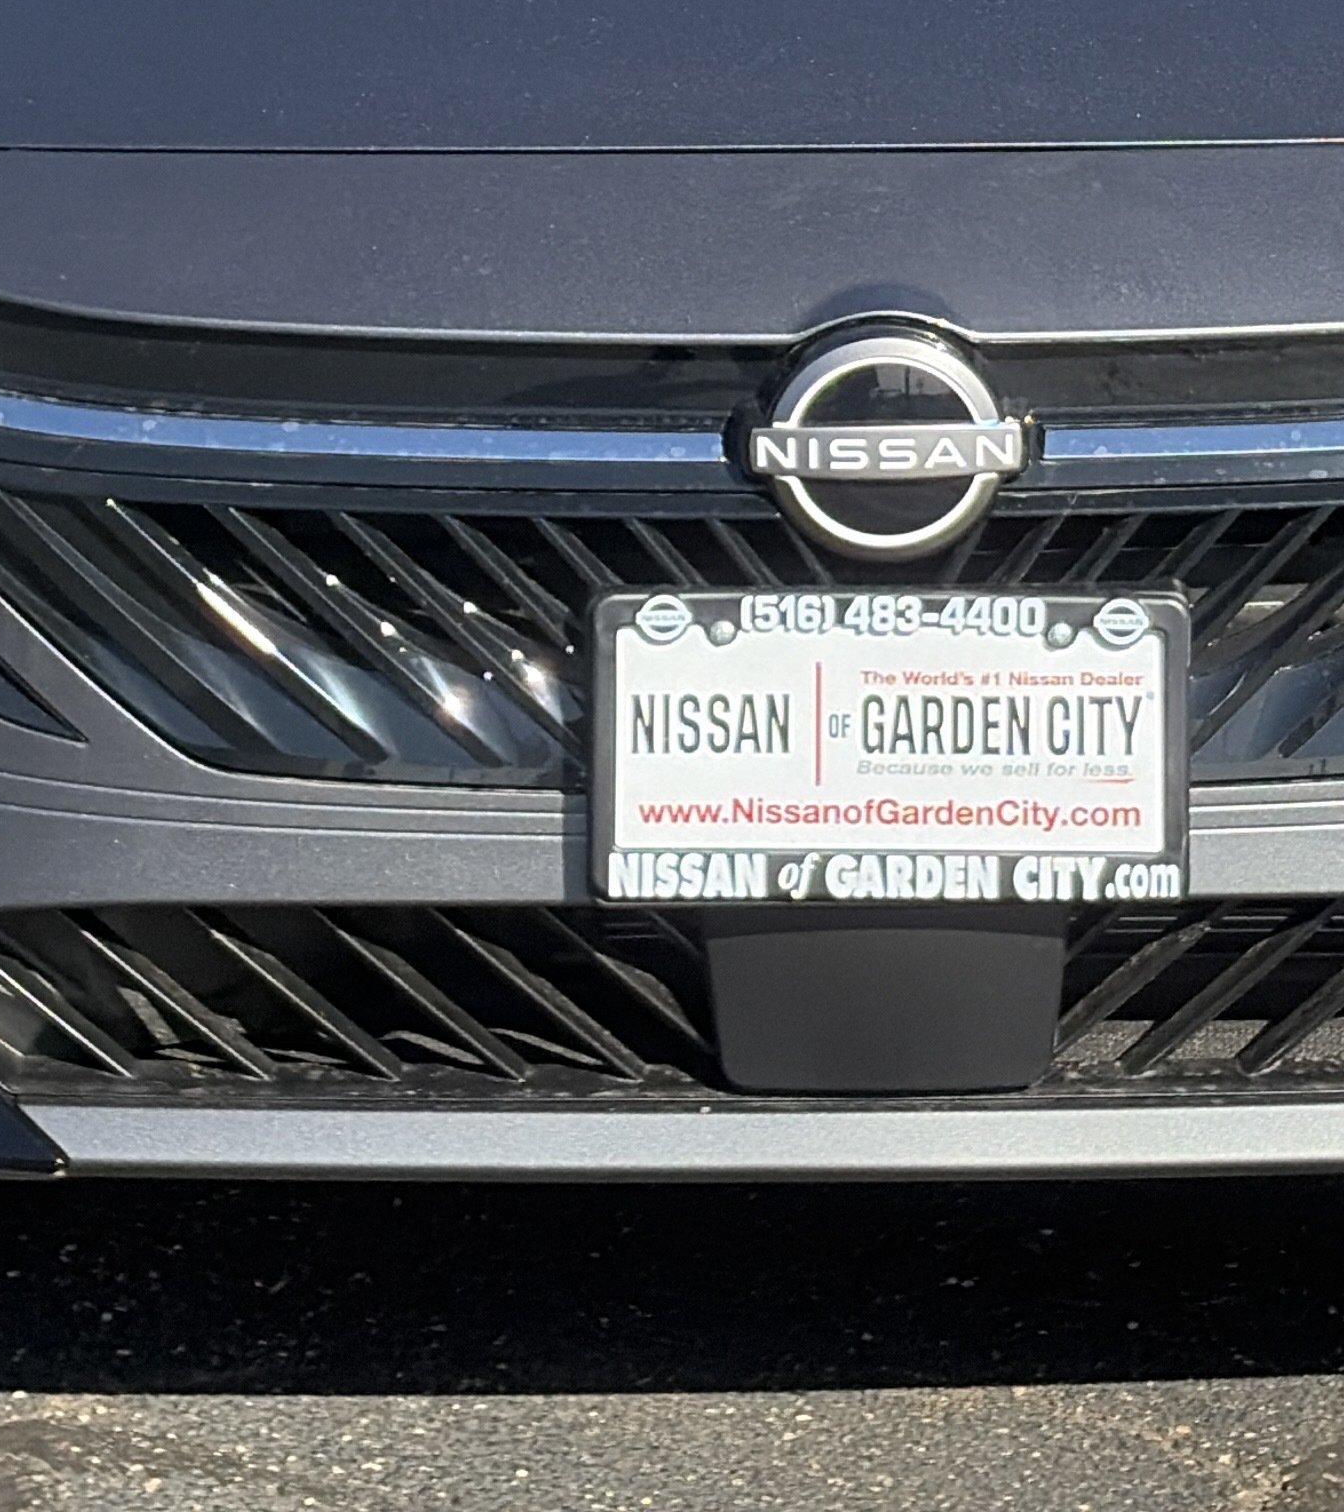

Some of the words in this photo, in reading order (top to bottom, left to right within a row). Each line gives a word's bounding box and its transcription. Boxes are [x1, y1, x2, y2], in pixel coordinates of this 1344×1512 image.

[756, 434, 1015, 470] NISSAN
[740, 595, 835, 633] (516)
[845, 595, 1046, 636] 483-4400
[860, 670, 896, 685] The
[902, 671, 974, 686] World's
[980, 672, 1000, 686] #1
[1009, 672, 1074, 686] Nissan
[1081, 672, 1145, 686] Dealer
[630, 694, 790, 754] NISSAN
[829, 714, 850, 738] OF
[861, 694, 1031, 756] GARDEN
[1047, 695, 1143, 756] CITY
[856, 760, 954, 776] Because
[960, 765, 993, 776] we
[1001, 763, 1040, 777] sell
[1047, 762, 1076, 776] for
[1082, 763, 1133, 778] less.
[639, 798, 1141, 831] www.NissanofGardenCity.com
[608, 853, 766, 898] NISSAN
[778, 852, 821, 900] of
[825, 854, 1000, 899] GARDEN
[1013, 856, 1181, 901] CITY.com
